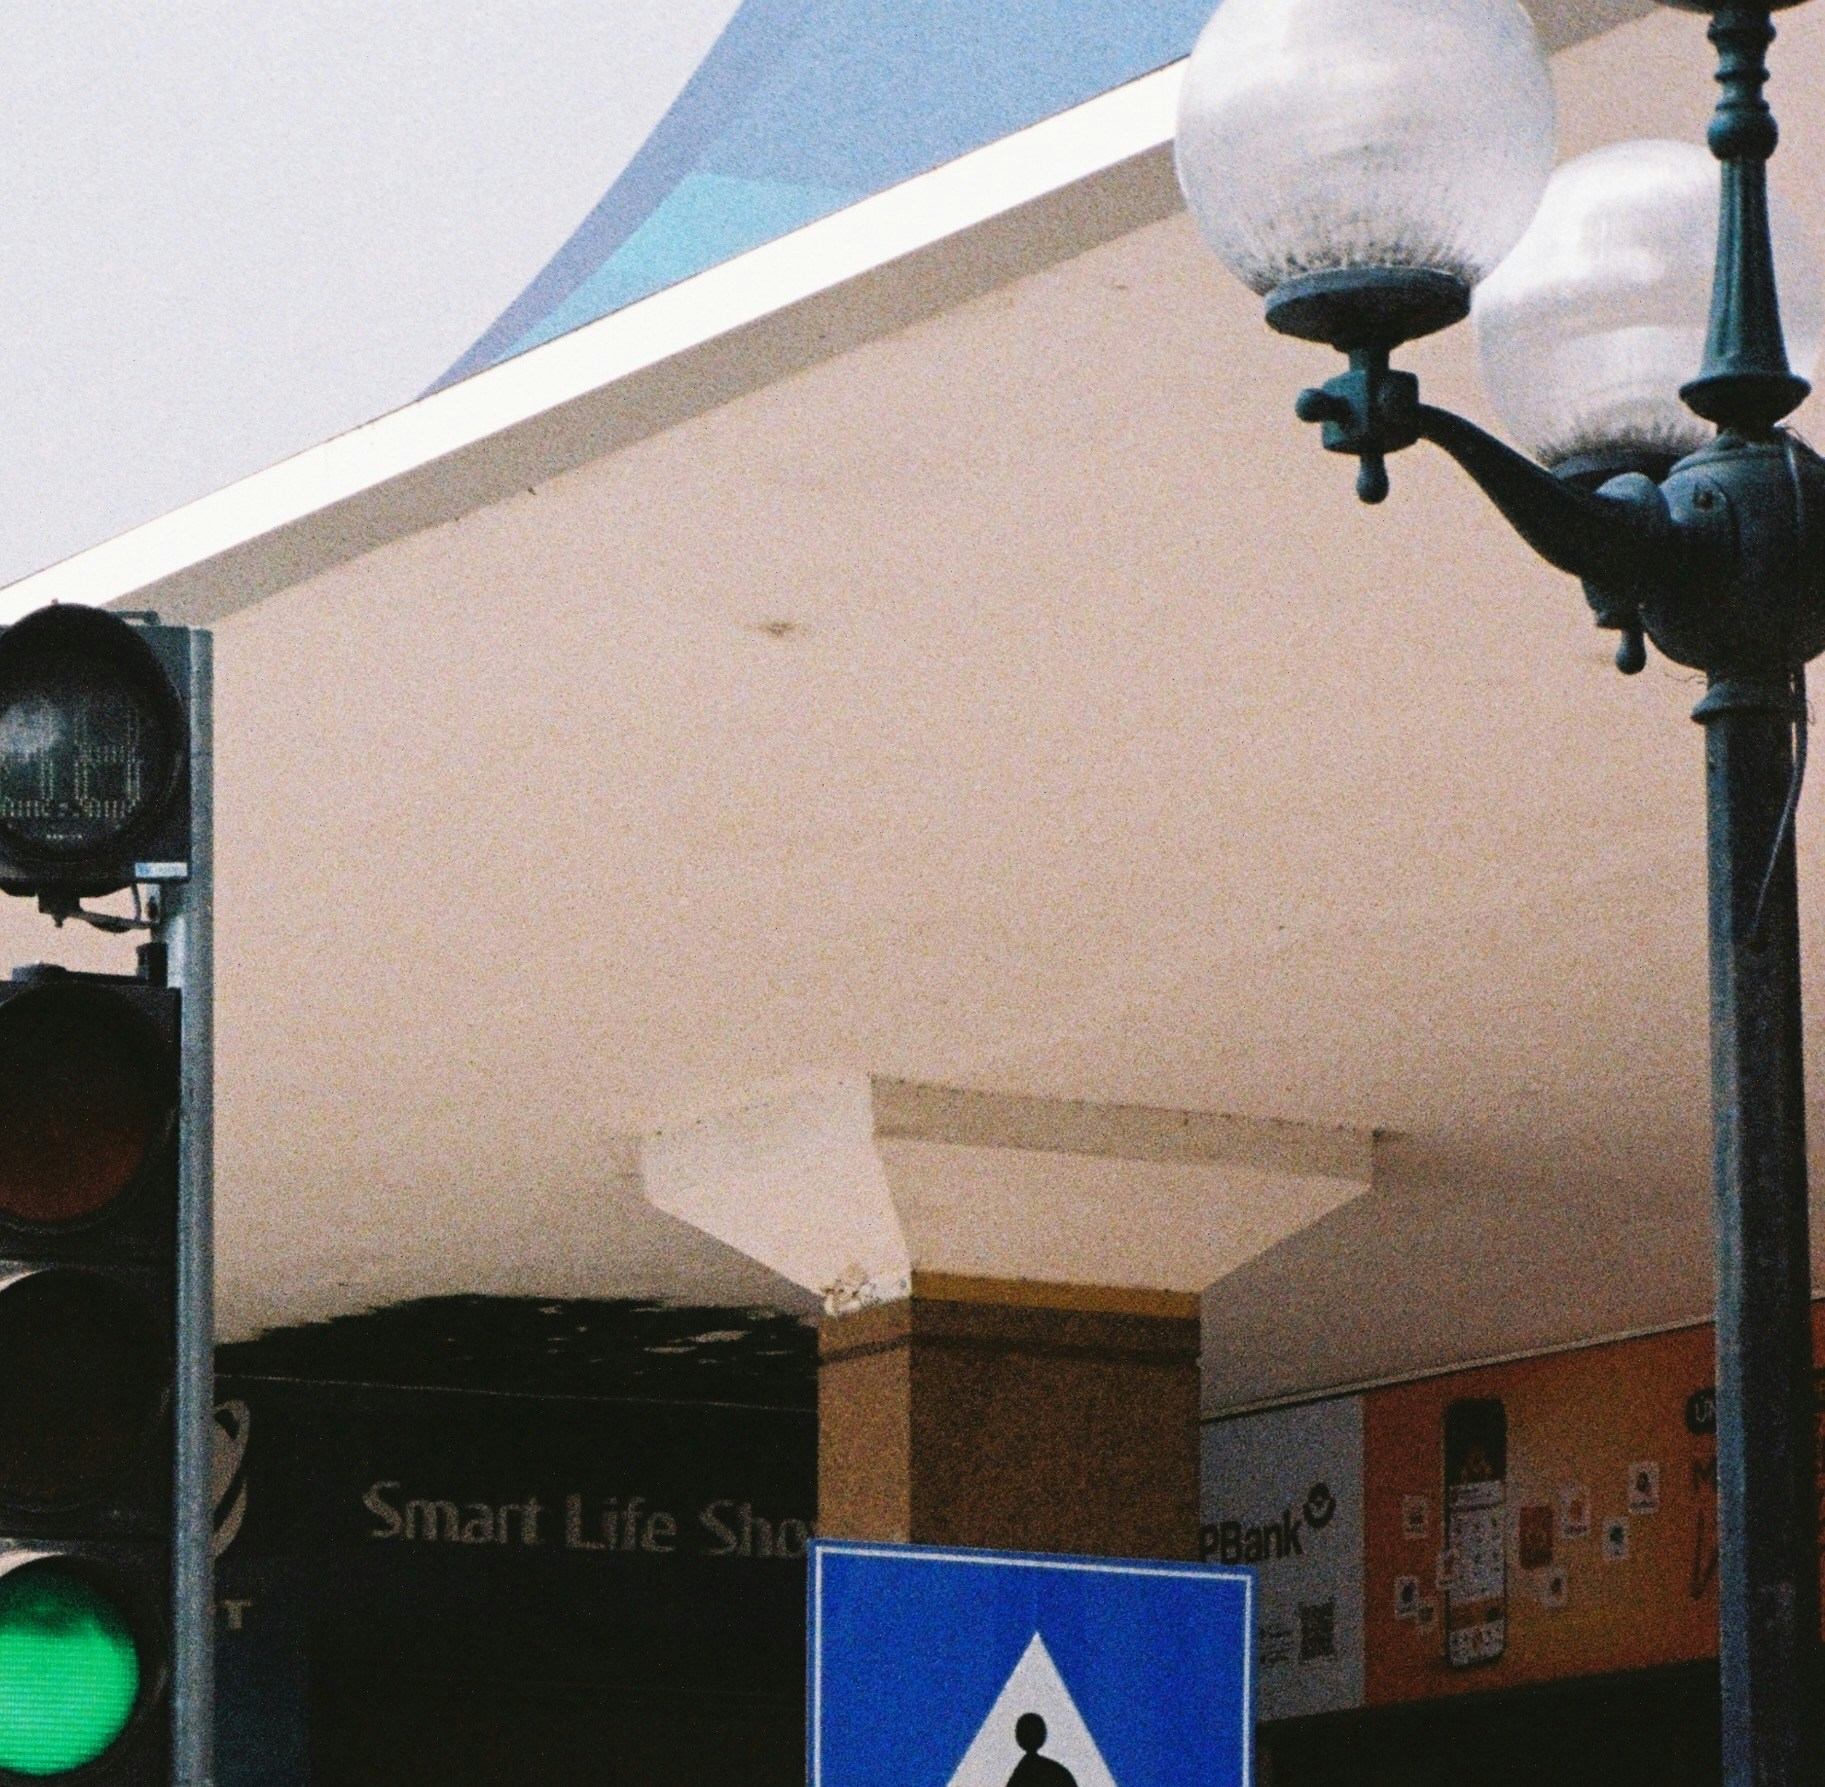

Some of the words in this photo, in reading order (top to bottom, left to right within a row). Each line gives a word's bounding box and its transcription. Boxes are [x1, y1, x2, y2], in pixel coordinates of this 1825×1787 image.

[362, 1480, 544, 1546] Smart
[566, 1491, 678, 1554] Life
[697, 1499, 816, 1558] Sho
[1199, 1508, 1304, 1565] PBank
